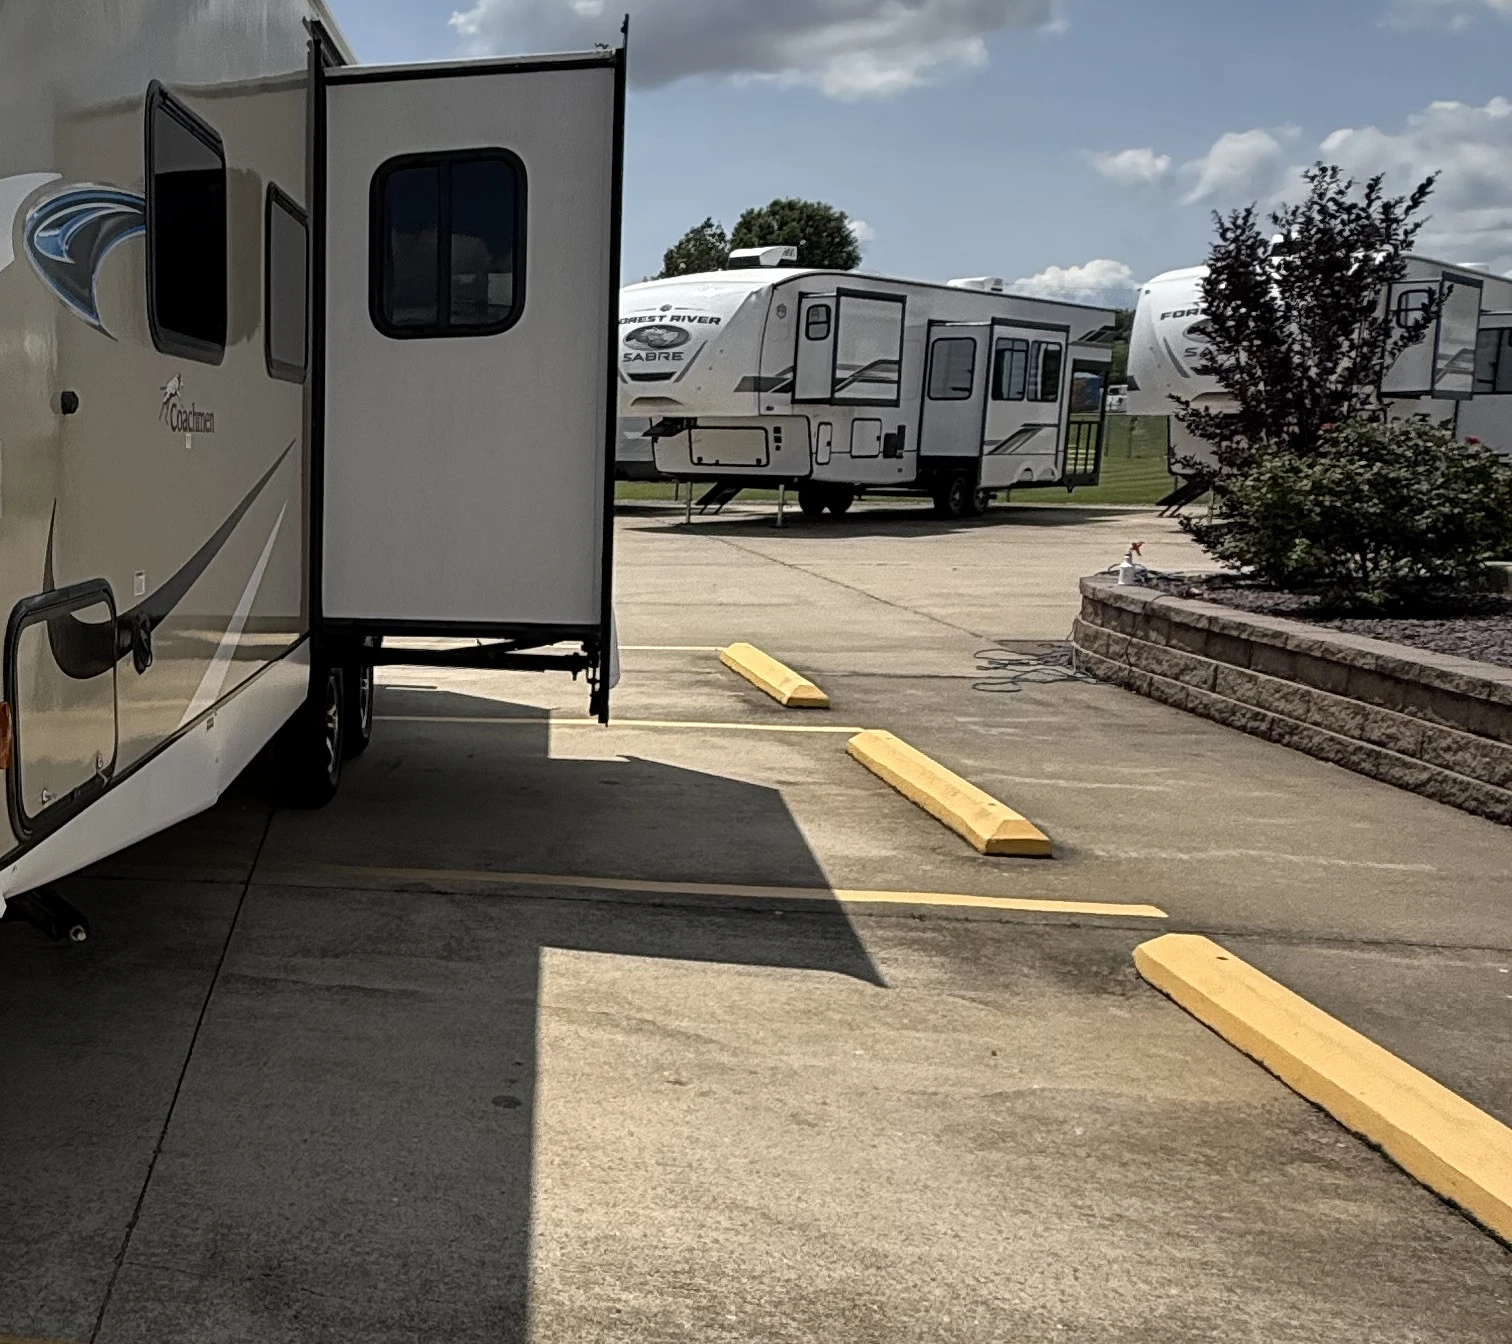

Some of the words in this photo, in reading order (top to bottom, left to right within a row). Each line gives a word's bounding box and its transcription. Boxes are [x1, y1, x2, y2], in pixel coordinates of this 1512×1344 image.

[619, 315, 667, 325] OREST
[669, 315, 722, 325] RIVER
[622, 352, 685, 363] SABRE
[170, 402, 215, 433] Coachmen
